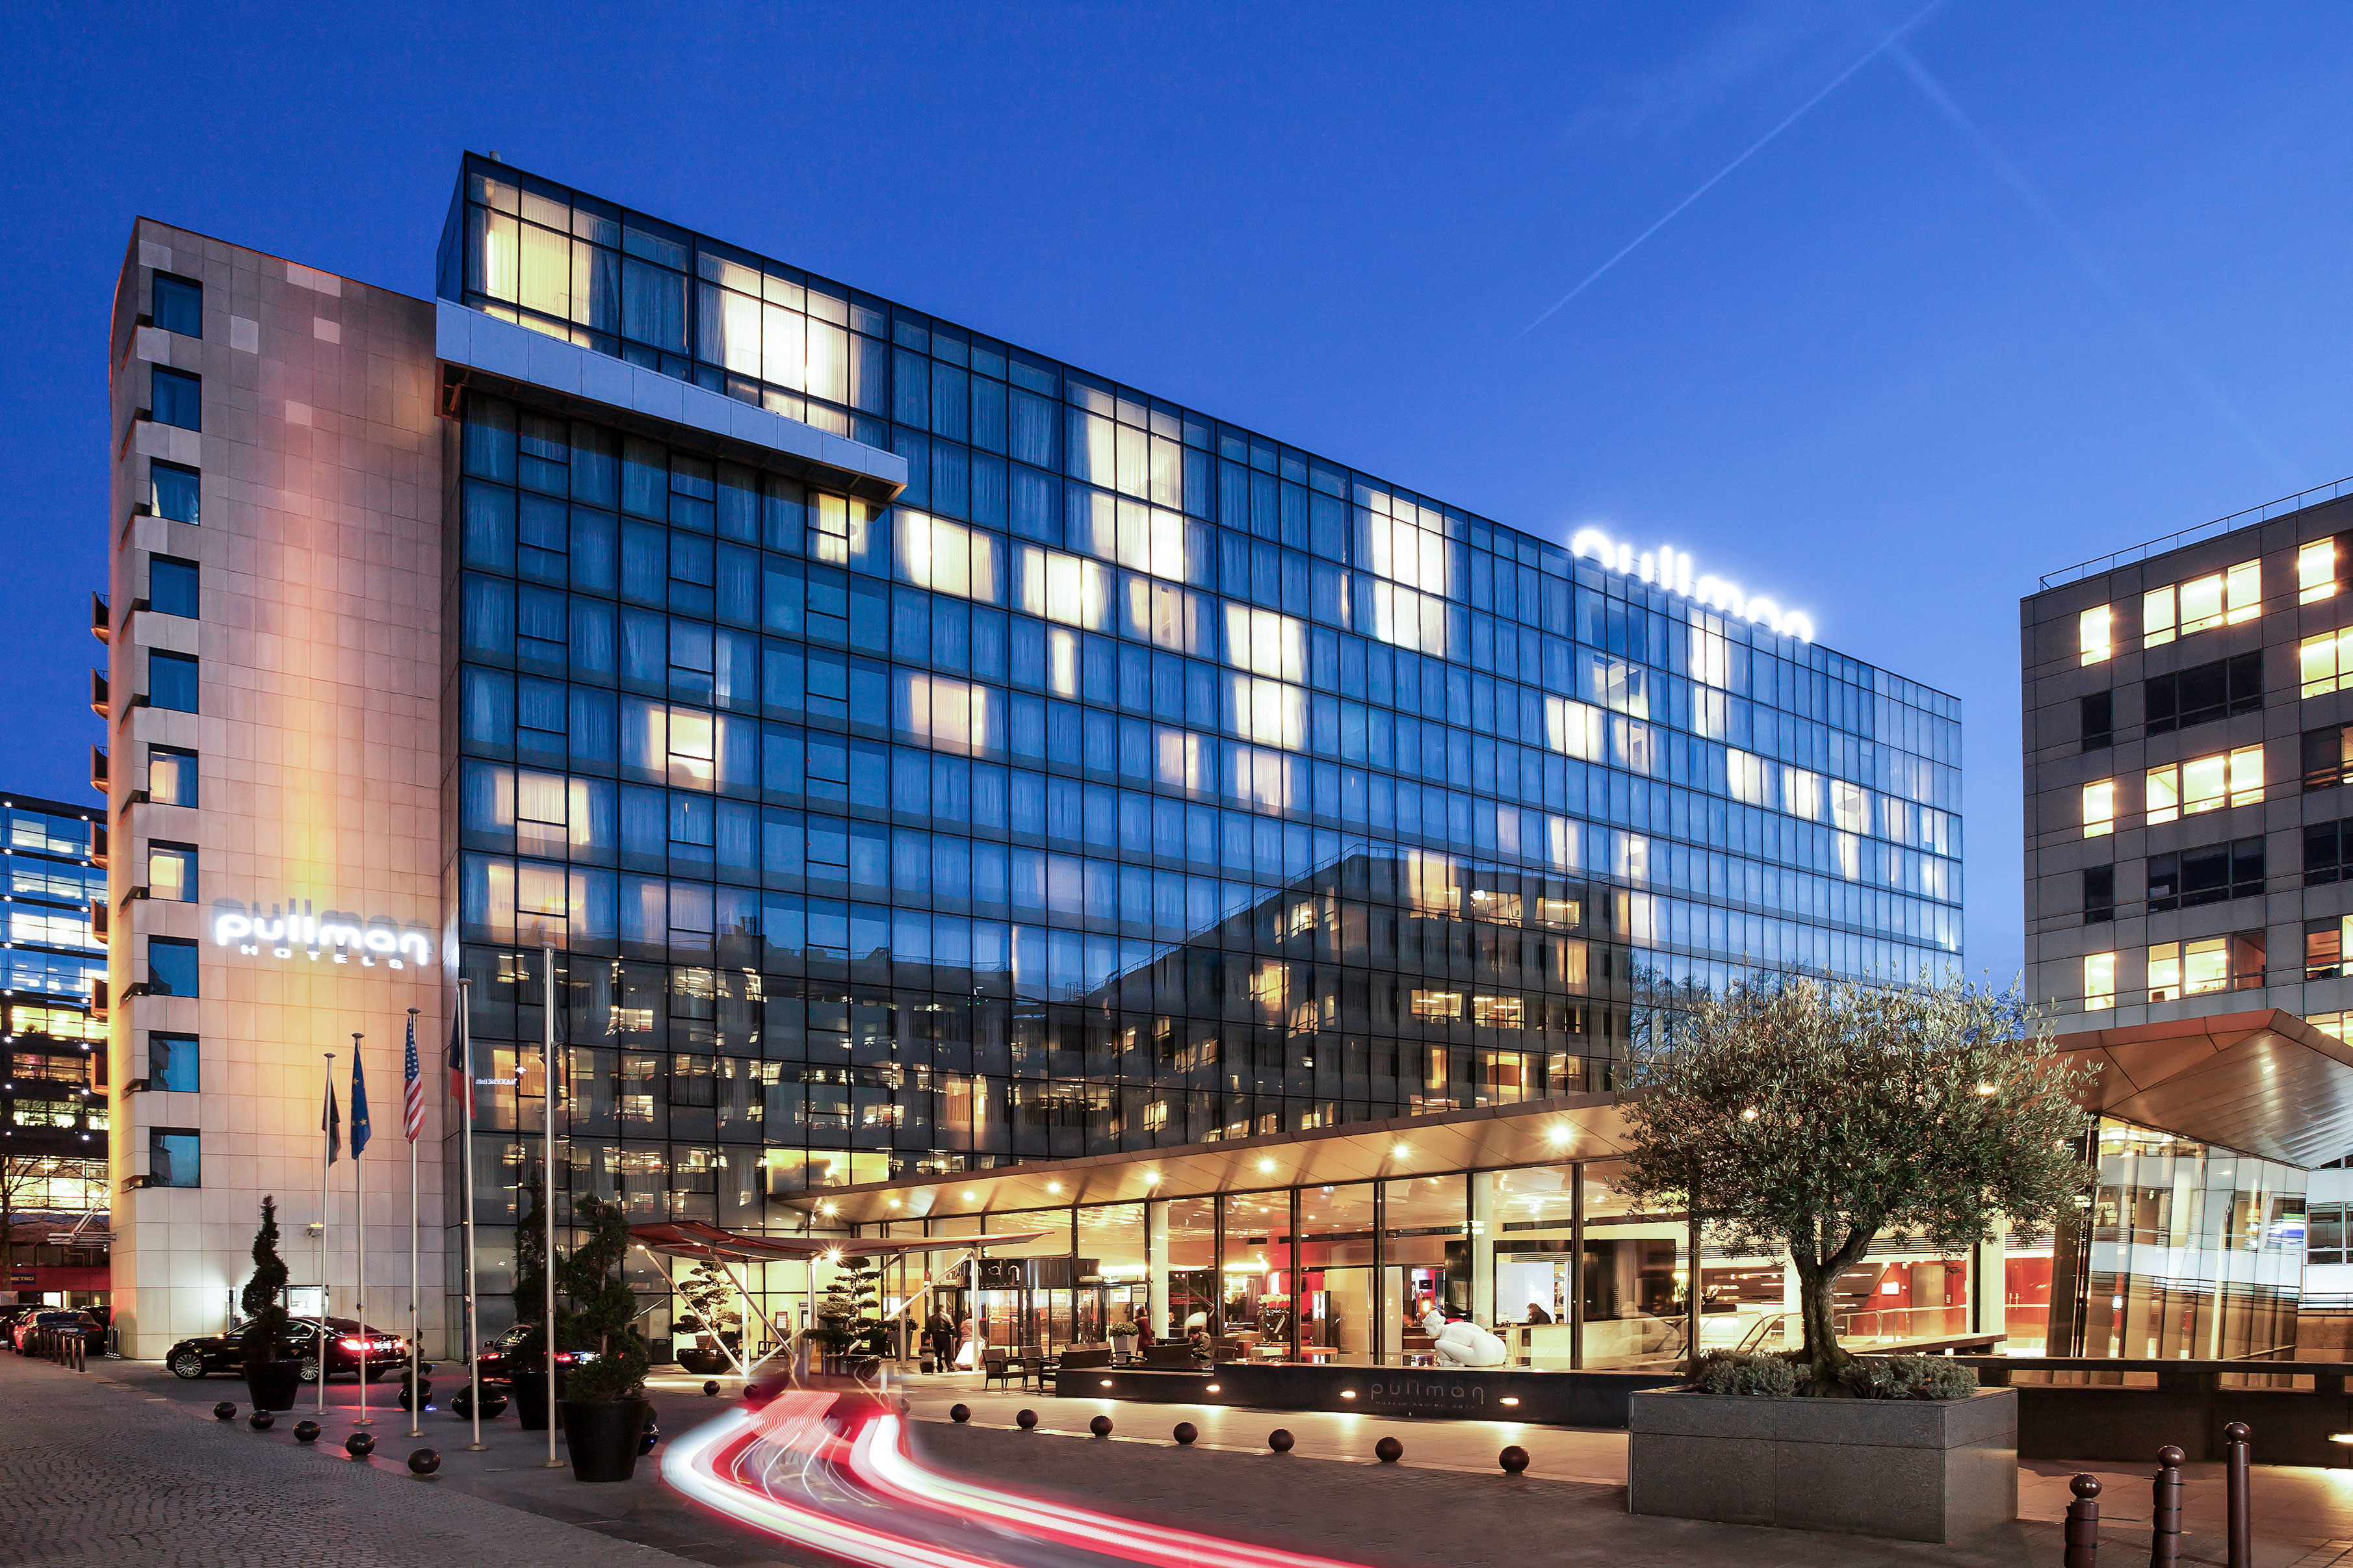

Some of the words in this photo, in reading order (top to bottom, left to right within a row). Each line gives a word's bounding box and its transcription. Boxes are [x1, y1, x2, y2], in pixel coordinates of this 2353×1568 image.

[216, 913, 428, 966] pullman
[240, 944, 404, 970] HOTELS
[1371, 1380, 1484, 1405] pullman
